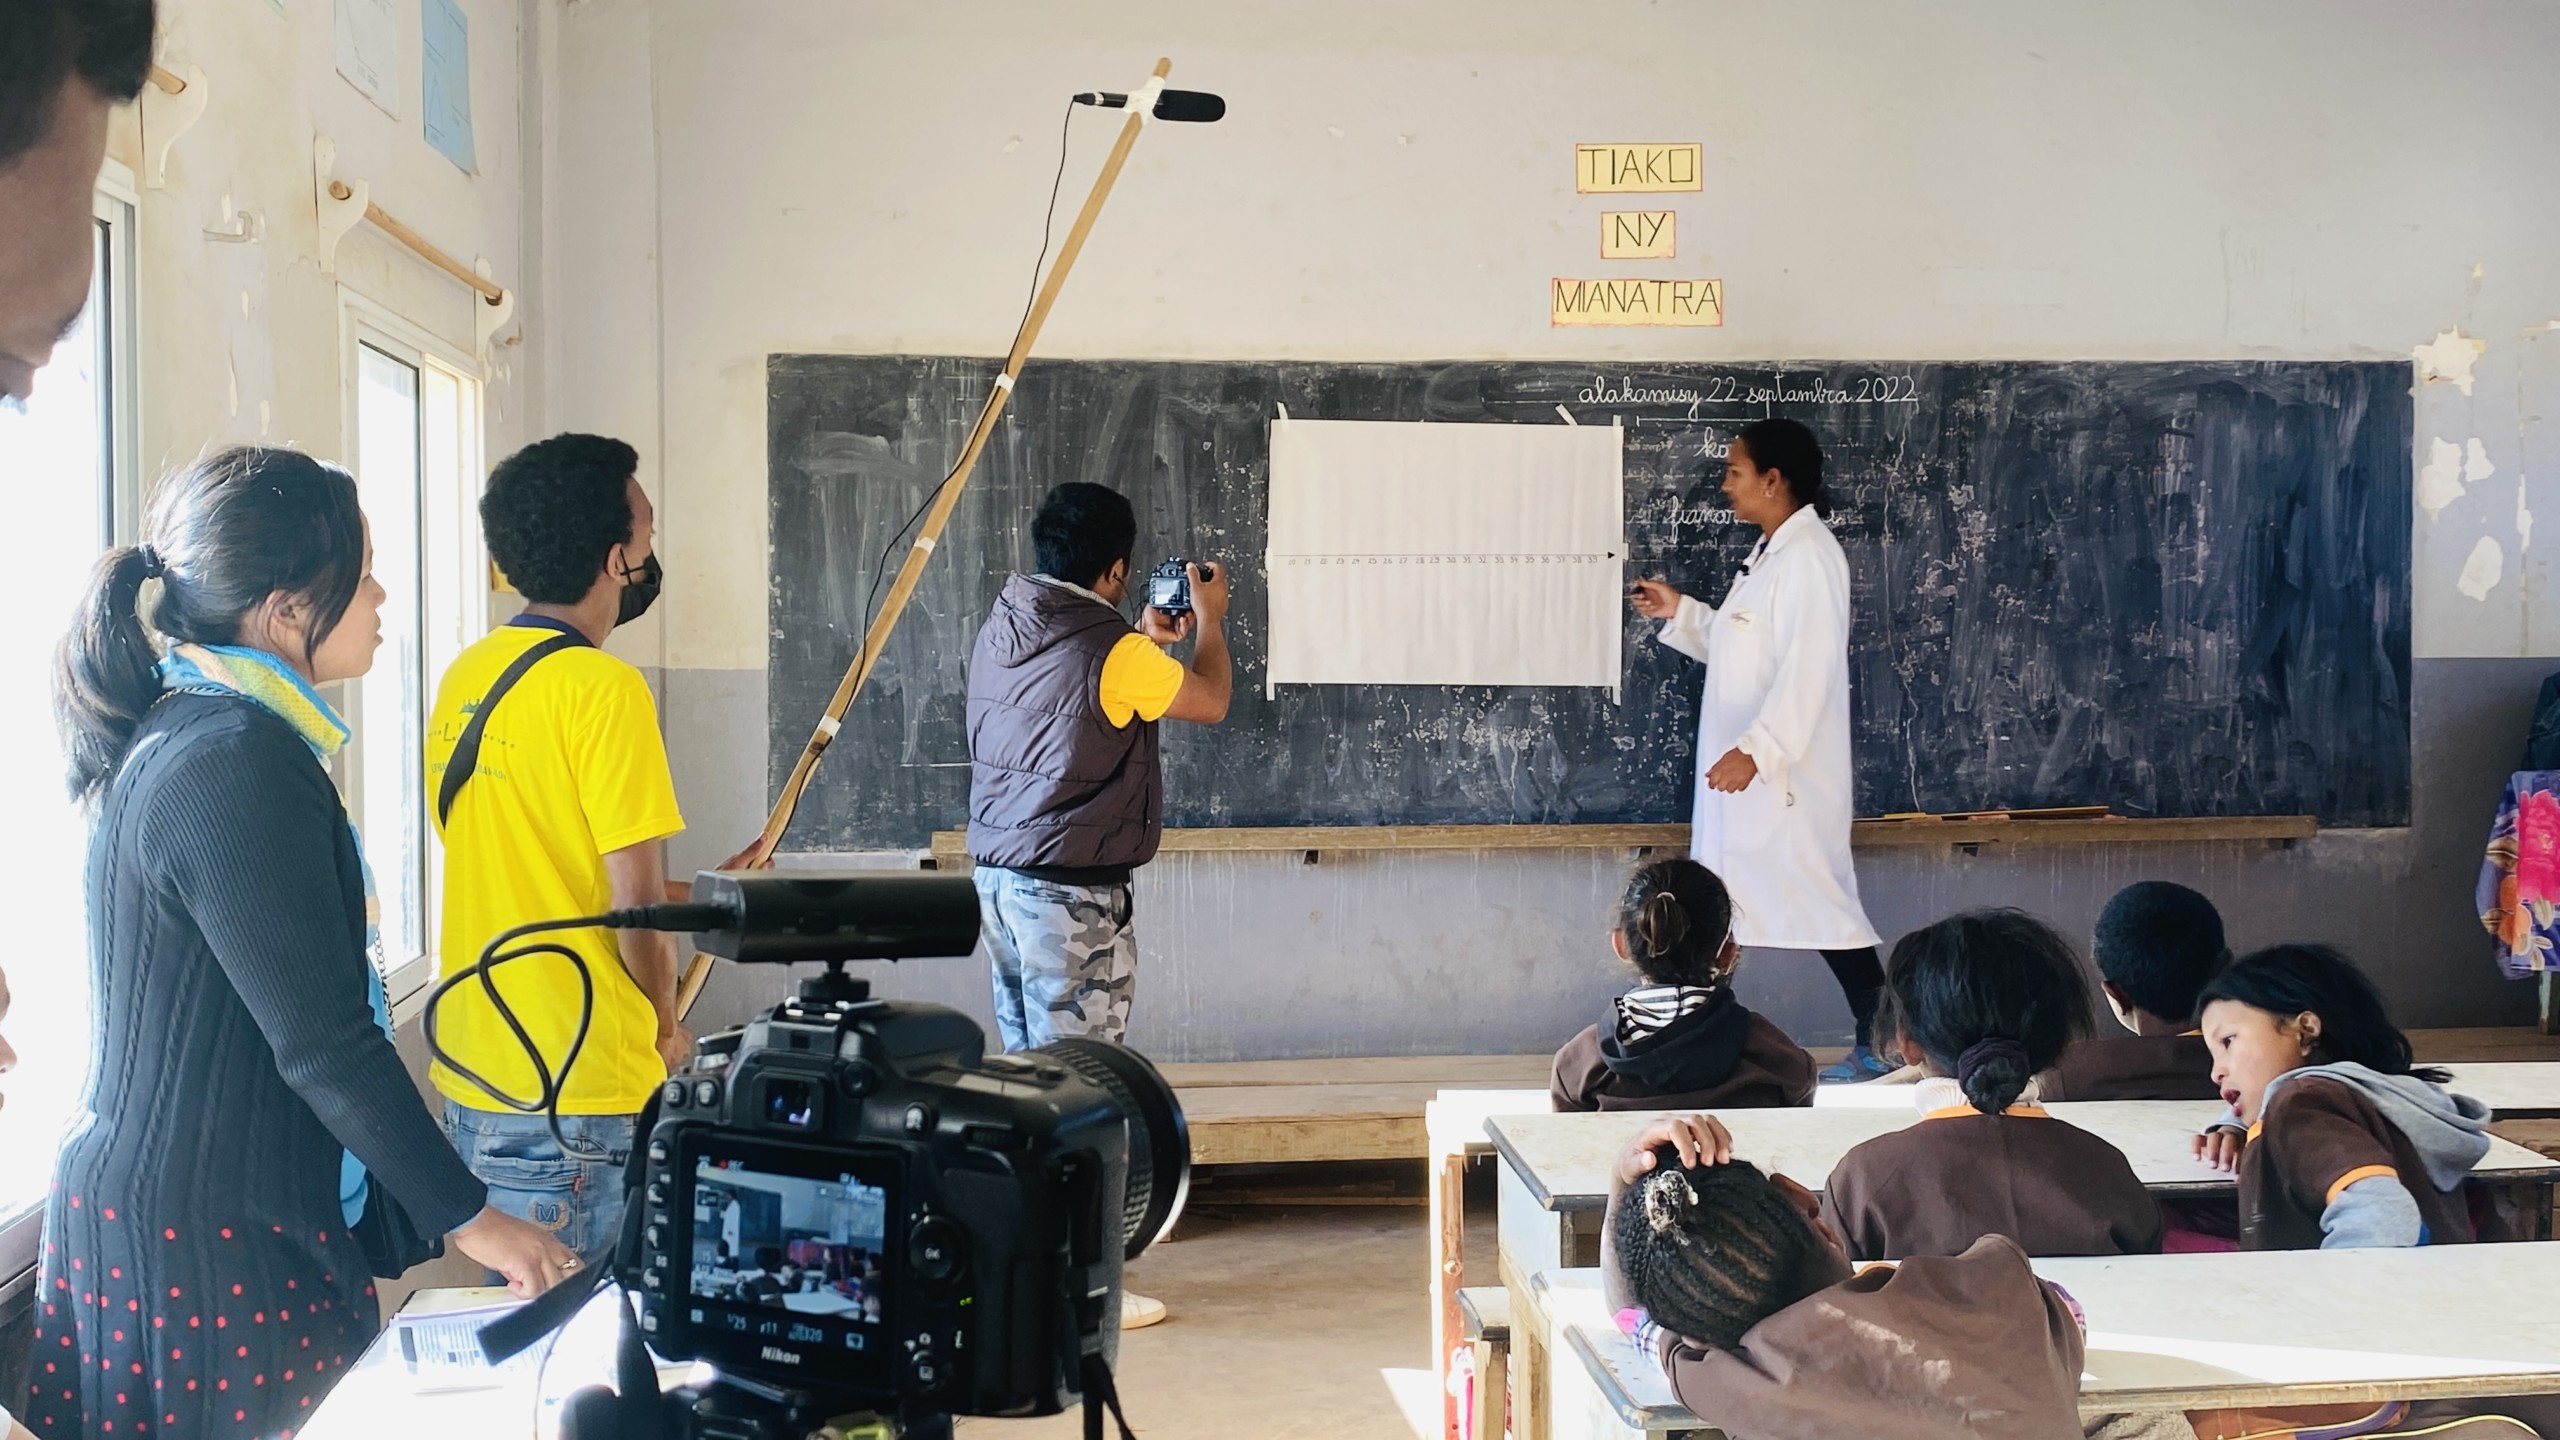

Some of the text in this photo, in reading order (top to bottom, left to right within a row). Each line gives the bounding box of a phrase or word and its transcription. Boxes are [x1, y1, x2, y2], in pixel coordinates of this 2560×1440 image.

[1578, 147, 1694, 186] TIAKO
[1615, 212, 1668, 249] NY
[1555, 279, 1720, 315] MIANATRA
[1578, 375, 1703, 422] alakamisy
[1705, 375, 1739, 403] 22
[1855, 375, 1919, 403] 2022
[761, 1345, 801, 1365] Nikon
